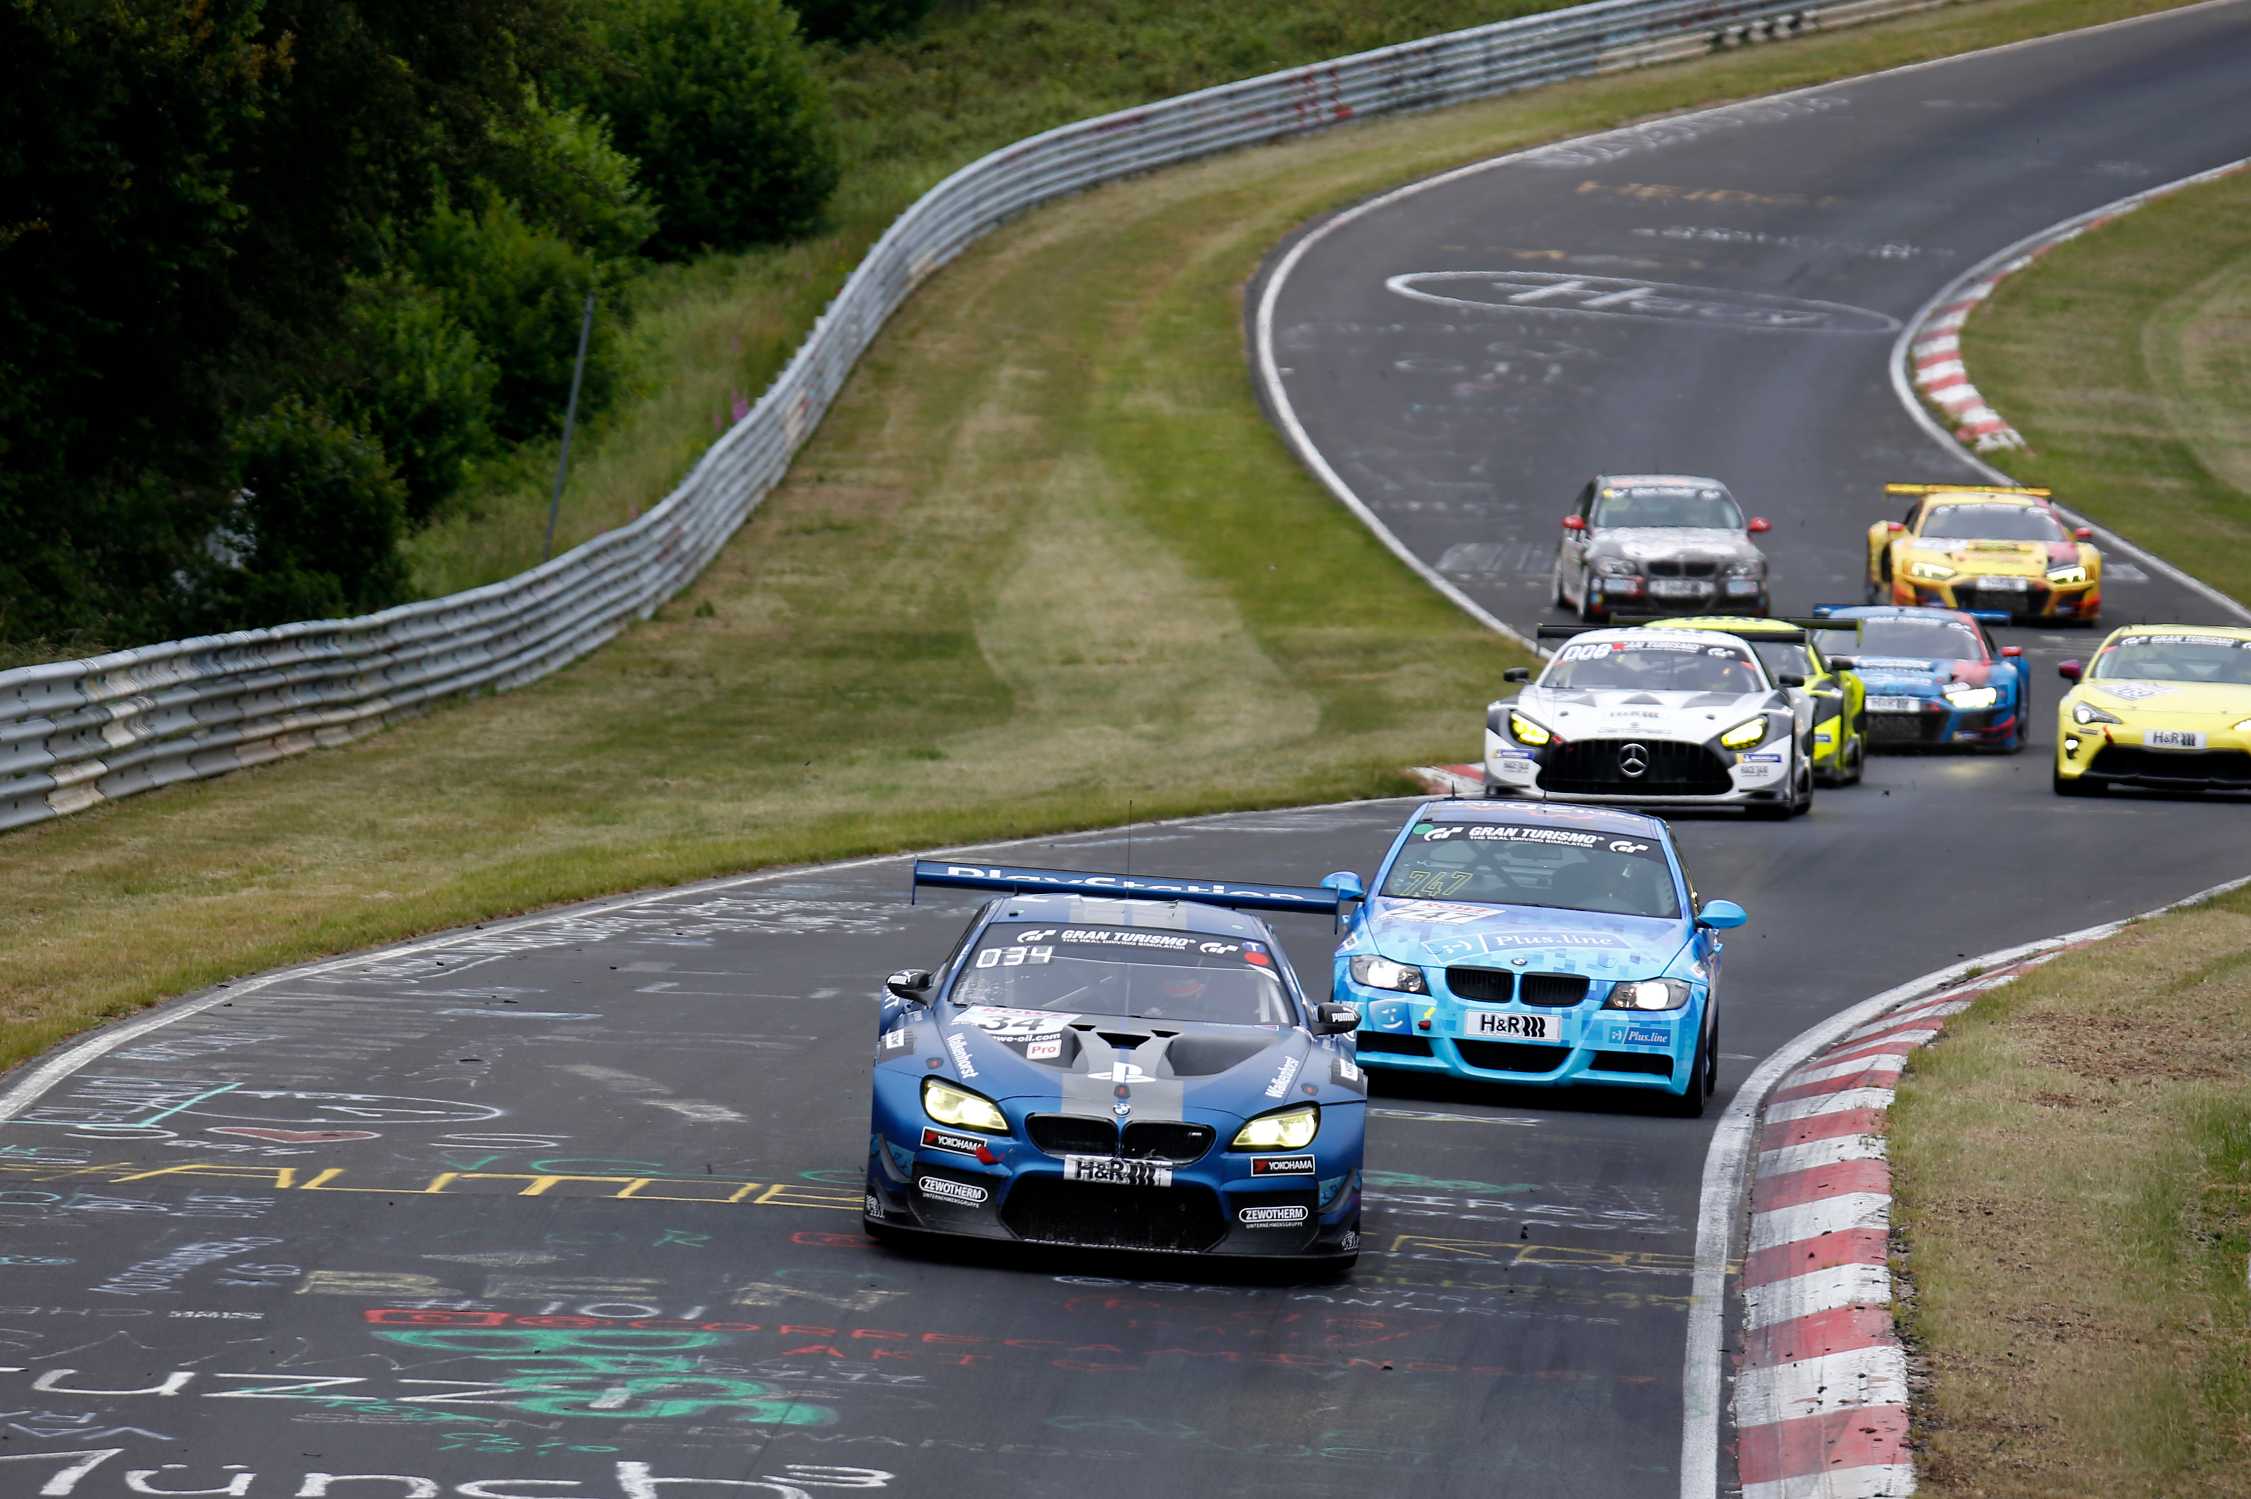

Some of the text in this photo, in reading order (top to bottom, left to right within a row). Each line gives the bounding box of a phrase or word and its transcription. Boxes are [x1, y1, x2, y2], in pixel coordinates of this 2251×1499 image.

[1469, 827, 1518, 837] GRAN
[1522, 828, 1597, 844] TURISMO
[1400, 871, 1473, 897] 747
[1061, 930, 1109, 941] GRAN
[1114, 932, 1187, 946] TURISMO
[1495, 933, 1615, 948] Plus.line
[976, 945, 1053, 969] 034
[977, 1016, 1045, 1031] 34
[1331, 1012, 1356, 1023] PUMA
[1480, 1014, 1520, 1034] H&R
[993, 1033, 1061, 1043] we-oil.com
[1627, 1031, 1669, 1044] Plus.line
[1031, 1045, 1057, 1055] Pro
[1268, 1159, 1313, 1171] YOKOHAMA
[924, 1178, 982, 1200] ZEWOTHERM
[1245, 1208, 1303, 1220] ZEWOTHERM
